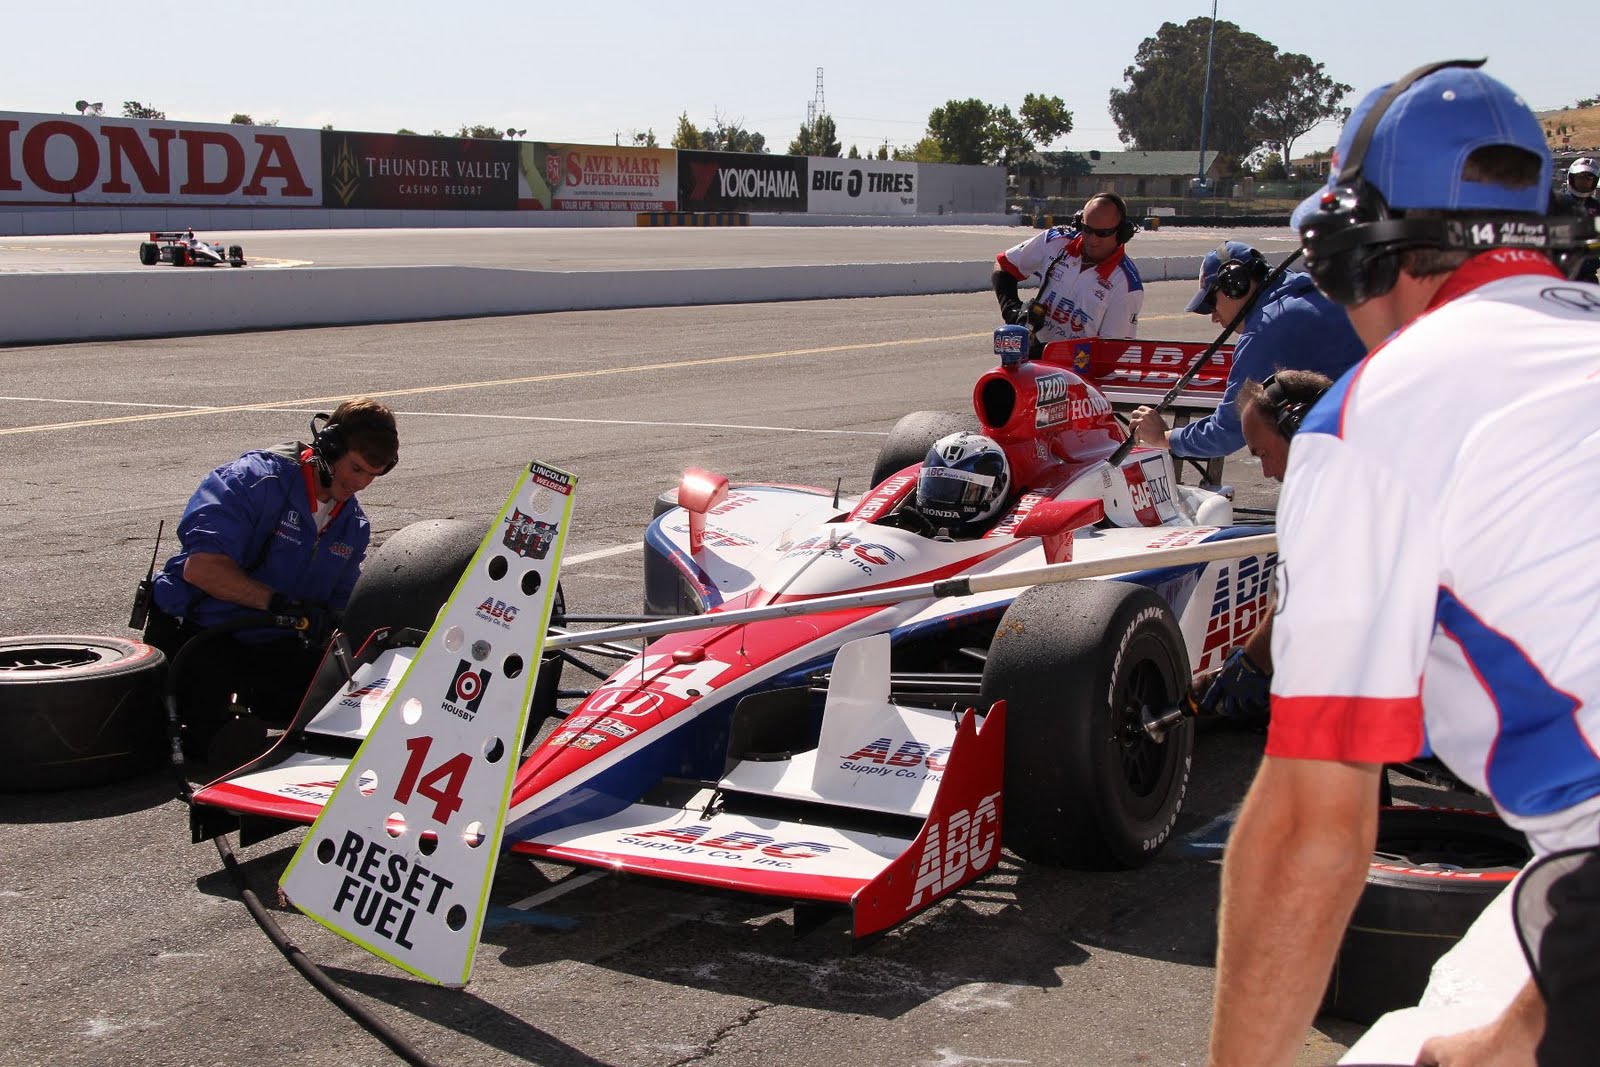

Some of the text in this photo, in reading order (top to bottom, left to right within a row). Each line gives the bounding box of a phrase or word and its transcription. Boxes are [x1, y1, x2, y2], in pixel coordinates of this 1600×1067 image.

[365, 157, 511, 180] THUNDER VALLEY
[616, 157, 660, 174] MART
[399, 184, 482, 195] CASINO RESORT
[718, 168, 799, 198] YOKOHAMA
[812, 170, 843, 191] BIG
[867, 172, 913, 193] TIRES
[561, 201, 578, 210] YOUR
[1471, 223, 1495, 245] 14
[1501, 234, 1546, 246] Racing
[1039, 376, 1067, 402] IZOD
[532, 464, 568, 485] LINCOLN
[925, 467, 944, 477] ABC
[536, 475, 568, 493] WELDERS
[922, 507, 960, 519] HONDA
[475, 610, 494, 623] Supply
[476, 596, 520, 623] ABC
[1193, 552, 1278, 676] AB
[441, 701, 475, 722] HOUSBY
[840, 737, 952, 771] ABC
[393, 735, 474, 825] 14
[839, 761, 893, 777] Supply
[895, 768, 918, 779] Co.
[616, 836, 700, 855] Supply
[707, 849, 744, 861] Co.
[621, 825, 850, 859] ABC
[905, 791, 1001, 912] ABC
[334, 829, 454, 915] RESET
[332, 875, 416, 951] FUEL
